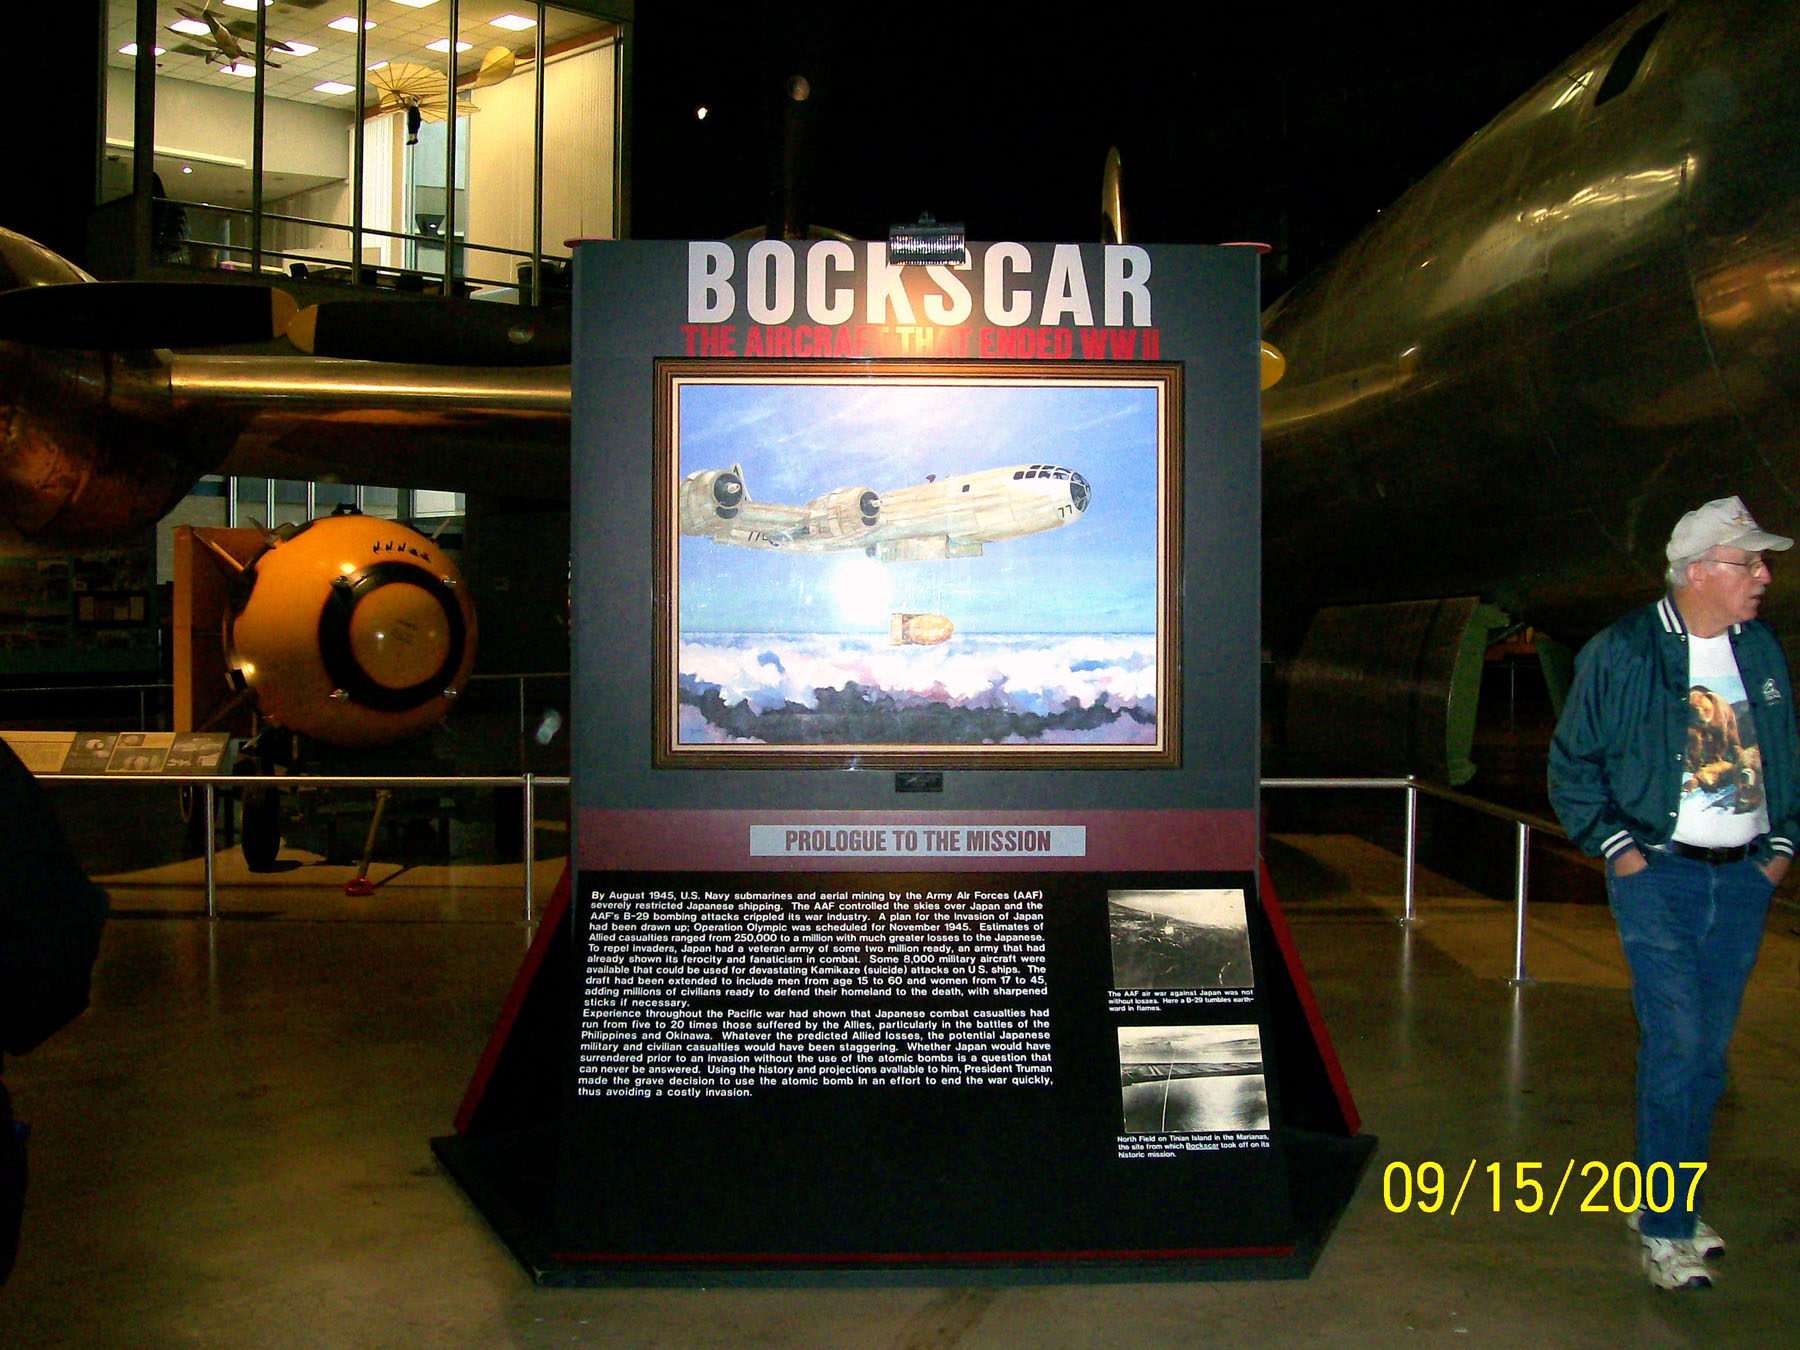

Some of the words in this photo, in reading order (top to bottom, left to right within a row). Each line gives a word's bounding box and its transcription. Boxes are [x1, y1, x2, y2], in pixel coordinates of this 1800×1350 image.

[687, 240, 1153, 327] BOCKSCAR
[680, 325, 736, 357] THE
[895, 326, 973, 358] THAT
[978, 327, 1073, 359] ENDED
[1057, 504, 1073, 518] 77
[785, 829, 886, 852] PROLOGUE
[893, 829, 918, 852] TO
[923, 829, 960, 852] THE
[966, 829, 1051, 852] MISSION
[591, 892, 605, 902] By
[609, 892, 645, 902] August
[649, 892, 677, 902] 1945,
[680, 892, 701, 901] U.S.
[704, 892, 730, 902] Navy
[734, 892, 793, 901] submarines
[796, 892, 816, 901] and
[820, 892, 848, 901] aerial
[852, 892, 885, 902] mining
[888, 892, 902, 902] by
[905, 892, 922, 901] the
[926, 892, 953, 902] Army
[956, 892, 971, 901] Air
[974, 892, 1010, 901] Forces
[1013, 892, 1043, 902] (AAF)
[590, 902, 632, 913] severely
[635, 902, 683, 911] restricted
[686, 902, 734, 913] Japanese
[738, 902, 783, 913] shipping.
[791, 902, 810, 911] The
[813, 902, 835, 911] AAF
[838, 902, 890, 911] controlled
[893, 902, 910, 911] the
[913, 902, 940, 911] skies
[969, 902, 1001, 913] Japan
[1004, 902, 1023, 911] and
[1026, 902, 1043, 911] the
[590, 913, 620, 921] AAF's
[623, 913, 650, 921] B-29
[653, 913, 697, 923] bombing
[700, 913, 740, 921] attacks
[743, 913, 785, 923] crippled
[788, 913, 801, 921] its
[826, 913, 871, 923] industry.
[878, 913, 886, 921] A
[890, 913, 912, 923] plan
[915, 913, 930, 921] for
[933, 913, 950, 921] the
[954, 913, 995, 921] invasion
[998, 913, 1009, 921] of
[1013, 913, 1044, 923] Japan
[589, 923, 608, 932] had
[611, 923, 637, 932] been
[640, 923, 671, 932] drawn
[674, 925, 690, 934] up;
[693, 923, 743, 934] Operation
[746, 923, 788, 934] Olympic
[815, 923, 868, 932] scheduled
[871, 923, 886, 932] for
[889, 923, 941, 932] November
[944, 923, 972, 932] 1945.
[979, 923, 1030, 932] Estimates
[1033, 923, 1044, 932] of
[1107, 990, 1122, 998] The
[1124, 990, 1139, 998] AAF
[1141, 990, 1151, 998] air
[1170, 990, 1198, 999] against
[1199, 990, 1223, 999] Japan
[584, 998, 616, 1007] sticks
[620, 998, 628, 1007] if
[631, 1000, 690, 1009] necessary.
[1162, 997, 1179, 1005] Here
[582, 1009, 642, 1020] Experience
[645, 1009, 702, 1020] throughout
[706, 1009, 724, 1018] the
[727, 1009, 762, 1018] Pacific
[788, 1009, 809, 1018] had
[812, 1009, 847, 1018] shown
[850, 1009, 871, 1018] that
[874, 1009, 926, 1020] Japanese
[929, 1009, 969, 1018] combat
[973, 1009, 1026, 1018] casualties
[1029, 1009, 1050, 1018] had
[603, 1020, 628, 1029] from
[632, 1020, 651, 1029] five
[655, 1020, 667, 1029] to
[670, 1020, 685, 1029] 20
[688, 1020, 718, 1029] times
[722, 1020, 752, 1029] those
[756, 1020, 801, 1029] suffered
[805, 1020, 819, 1031] by
[822, 1020, 840, 1029] the
[843, 1020, 875, 1031] Allies,
[878, 1020, 938, 1031] particularly
[941, 1020, 951, 1029] in
[955, 1020, 973, 1029] the
[976, 1020, 1014, 1029] battles
[1017, 1020, 1029, 1029] of
[1032, 1020, 1050, 1029] the
[581, 1031, 637, 1043] Philippines
[641, 1031, 662, 1041] and
[665, 1031, 713, 1041] Okinawa.
[721, 1031, 772, 1041] Whatever
[776, 1031, 793, 1041] the
[797, 1031, 848, 1043] predicted
[851, 1031, 881, 1041] Allied
[885, 1031, 923, 1043] losses,
[927, 1031, 945, 1041] the
[948, 1031, 996, 1043] potential
[999, 1031, 1051, 1043] Japanese
[1139, 1135, 1156, 1143] Field
[1131, 1143, 1145, 1151] site
[1146, 1143, 1163, 1151] from
[1220, 1142, 1237, 1150] took
[1118, 1151, 1145, 1159] historic
